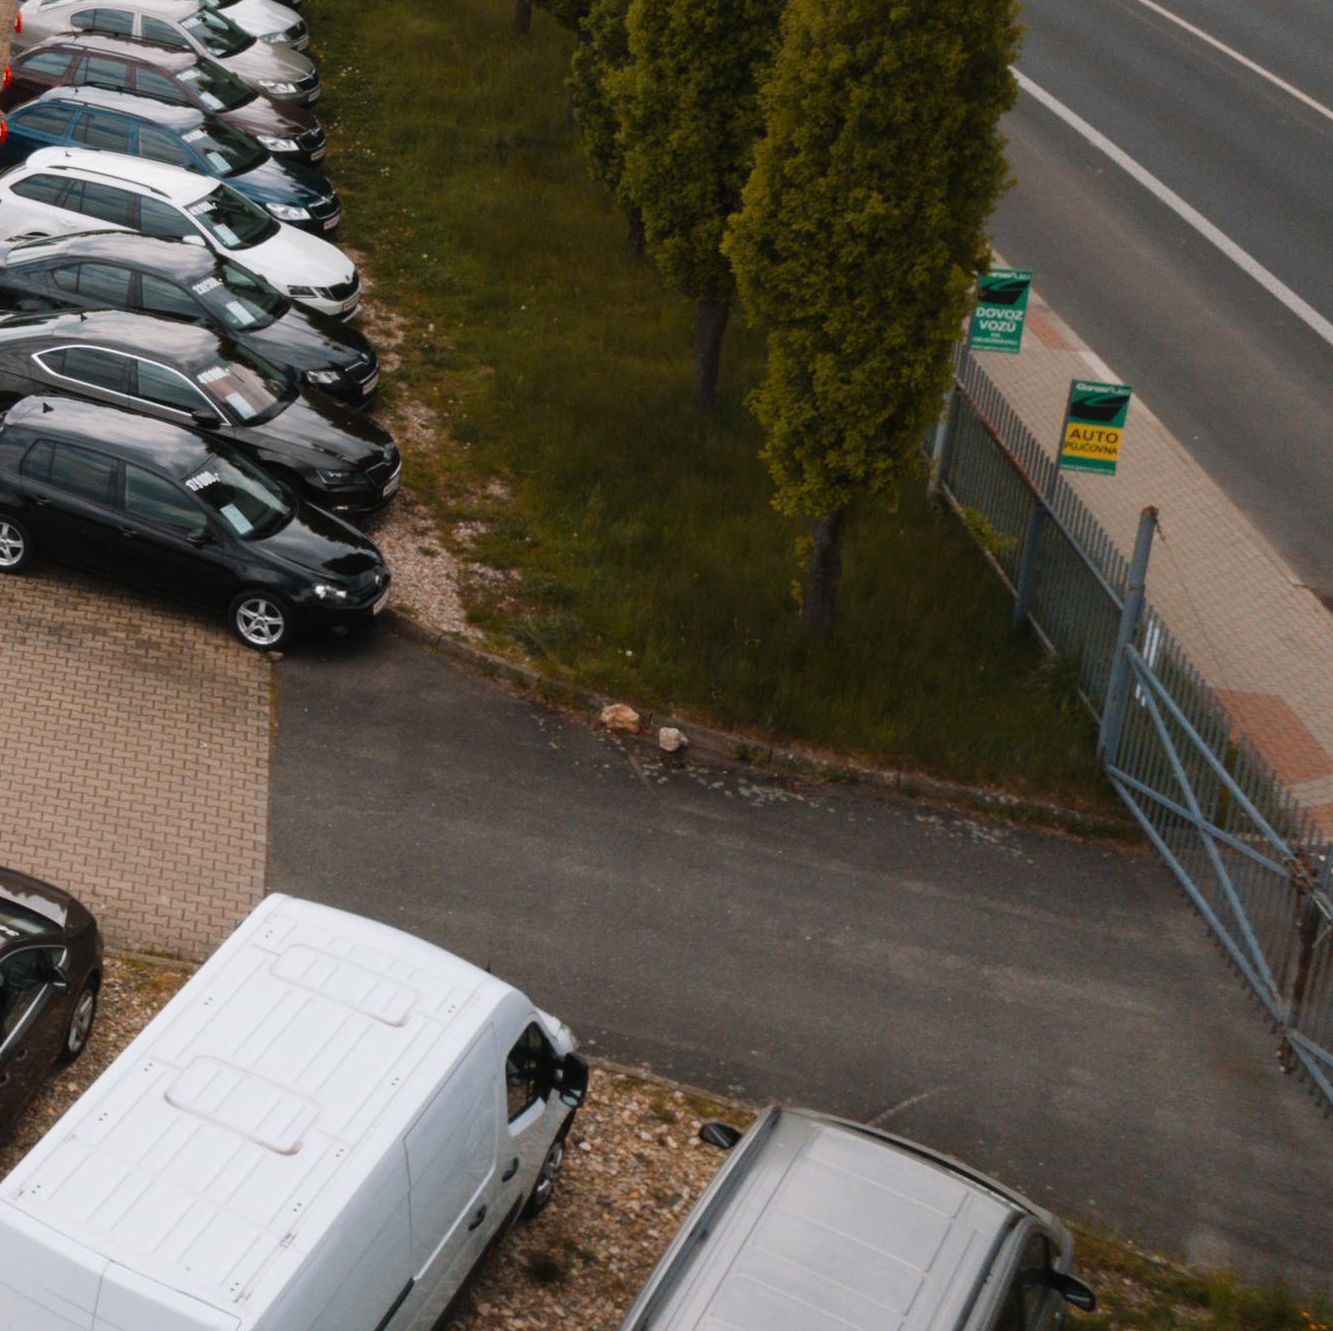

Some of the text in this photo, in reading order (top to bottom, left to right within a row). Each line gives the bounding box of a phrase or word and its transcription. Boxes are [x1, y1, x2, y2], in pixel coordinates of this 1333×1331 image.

[976, 307, 1023, 321] DOVOZ
[979, 318, 1017, 332] VOZŮ
[1070, 427, 1119, 444] AUTO
